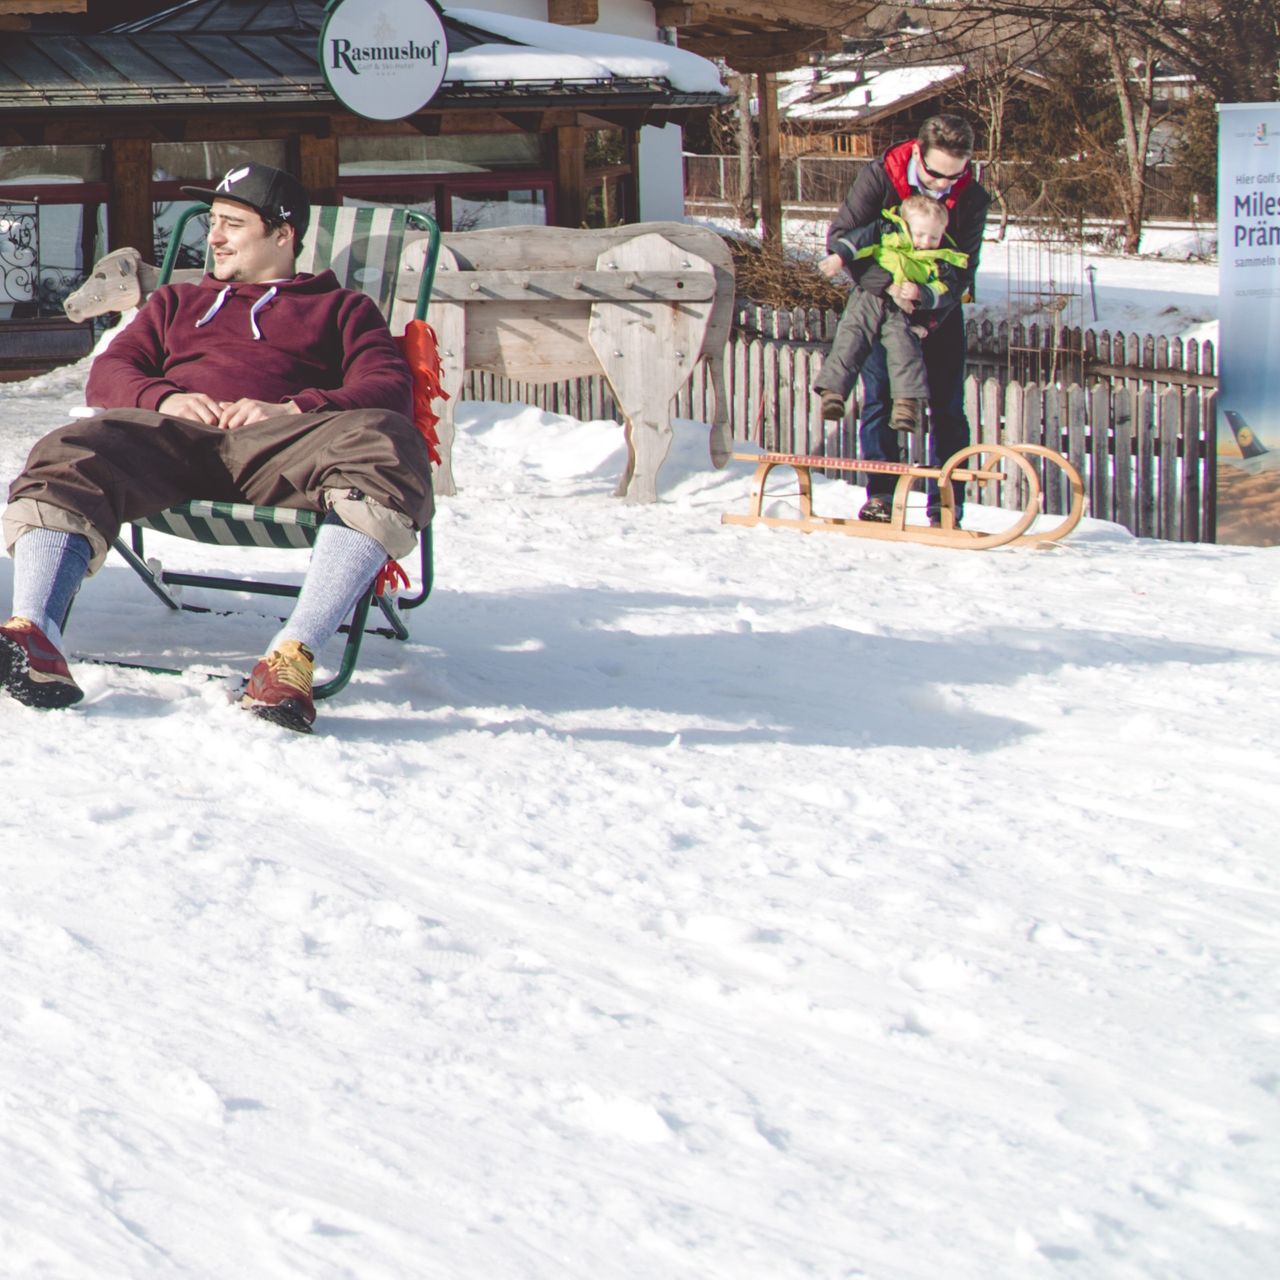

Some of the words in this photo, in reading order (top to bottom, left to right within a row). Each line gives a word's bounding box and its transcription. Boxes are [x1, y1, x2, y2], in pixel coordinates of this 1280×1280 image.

[330, 38, 440, 75] Rasmushof
[1236, 175, 1255, 185] Hier
[1257, 172, 1276, 184] Golf
[1234, 221, 1280, 248] Präm
[1235, 256, 1276, 268] sammeln
